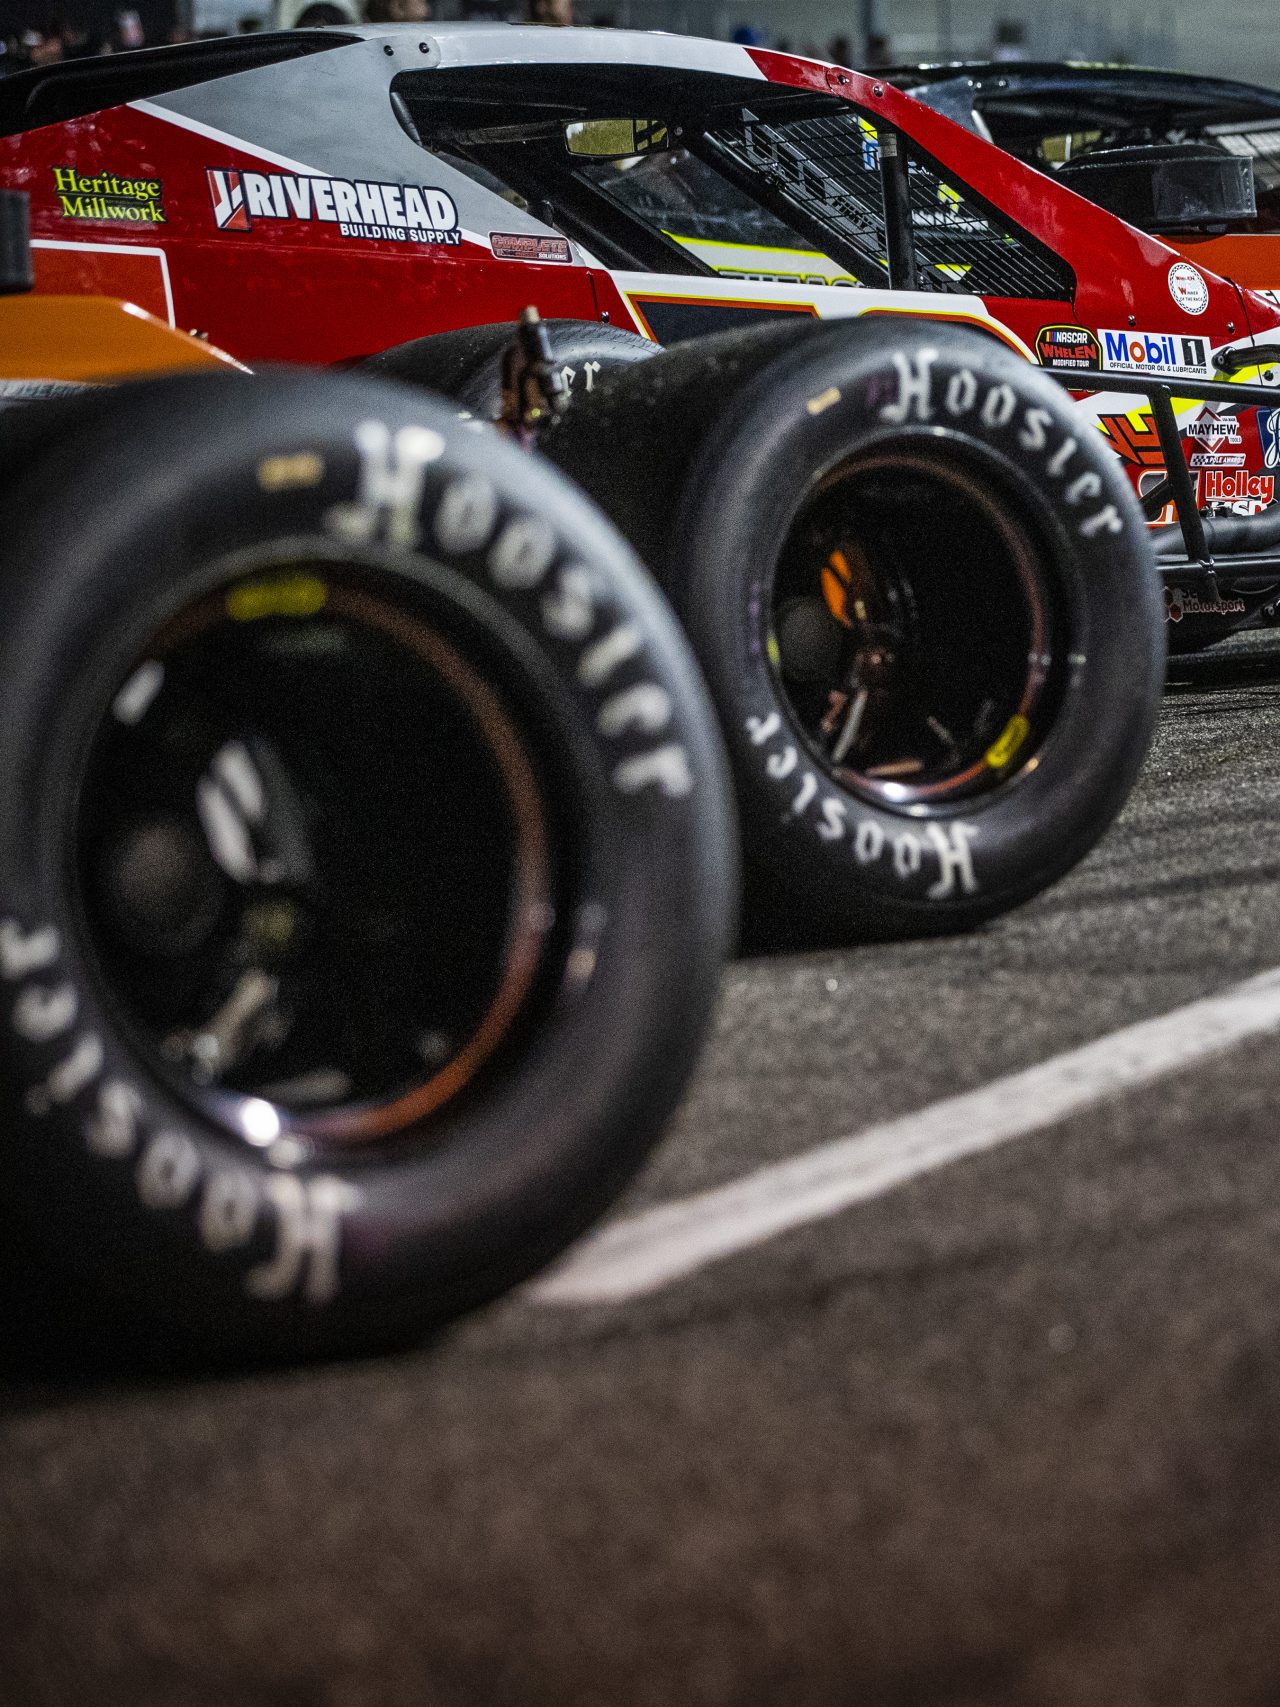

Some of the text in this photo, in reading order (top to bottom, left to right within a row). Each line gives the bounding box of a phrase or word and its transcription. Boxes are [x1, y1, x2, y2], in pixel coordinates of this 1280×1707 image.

[52, 167, 161, 200] Heritage
[59, 195, 166, 222] Millwork
[243, 172, 458, 231] RIVERHEAD
[340, 223, 462, 245] BUILDING SUPPLY
[492, 235, 567, 253] COMPLETE
[1039, 342, 1097, 360] WHELEN
[1057, 332, 1088, 343] NASCAR
[1105, 332, 1199, 366] Mobil 1
[1052, 359, 1090, 368] MODIFIED TOUR
[1110, 362, 1134, 370] OFFICIAL
[1188, 423, 1237, 435] MAYHEW
[880, 348, 1123, 538] Hoosier
[1205, 470, 1275, 504] Holley
[325, 420, 693, 797] Hoosier
[1183, 600, 1245, 615] Motorsport
[746, 710, 982, 899] Hoosier
[0, 917, 361, 1304] Hoosier
